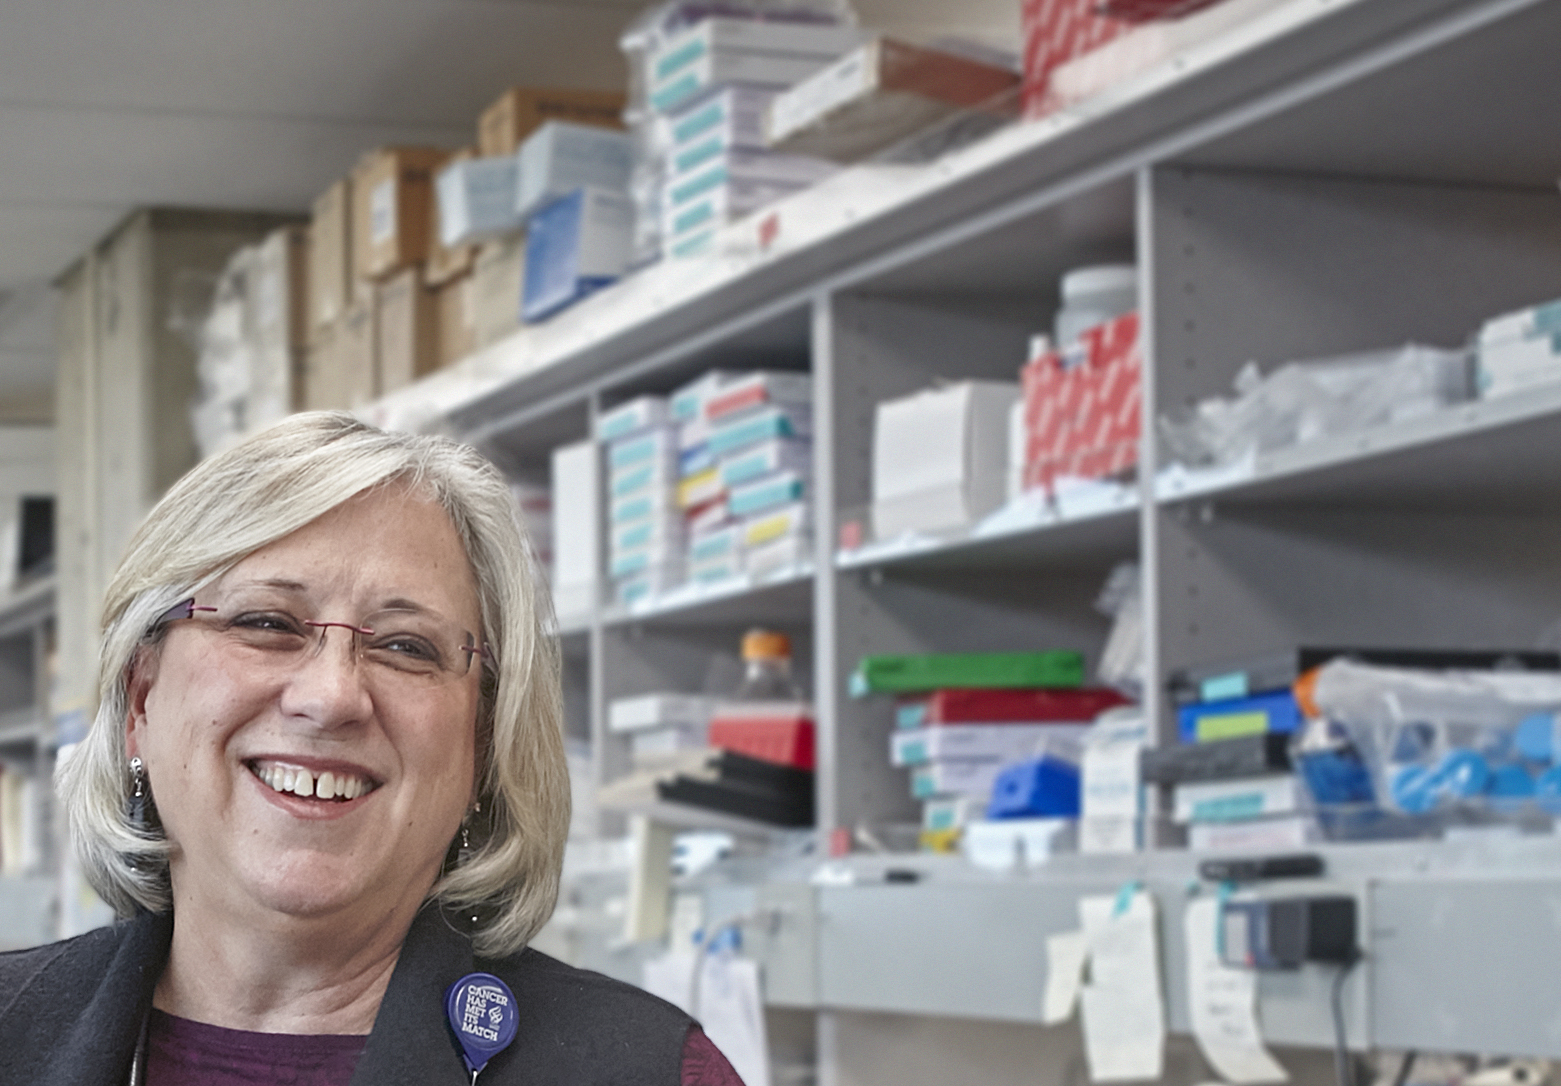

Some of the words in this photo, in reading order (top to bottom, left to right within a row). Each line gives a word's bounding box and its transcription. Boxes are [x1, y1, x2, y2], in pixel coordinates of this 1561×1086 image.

[467, 994, 487, 1009] HAS
[468, 985, 508, 1006] CANCER
[465, 1003, 486, 1018] MET
[464, 1013, 479, 1025] ITS
[461, 1021, 498, 1041] MATCH
